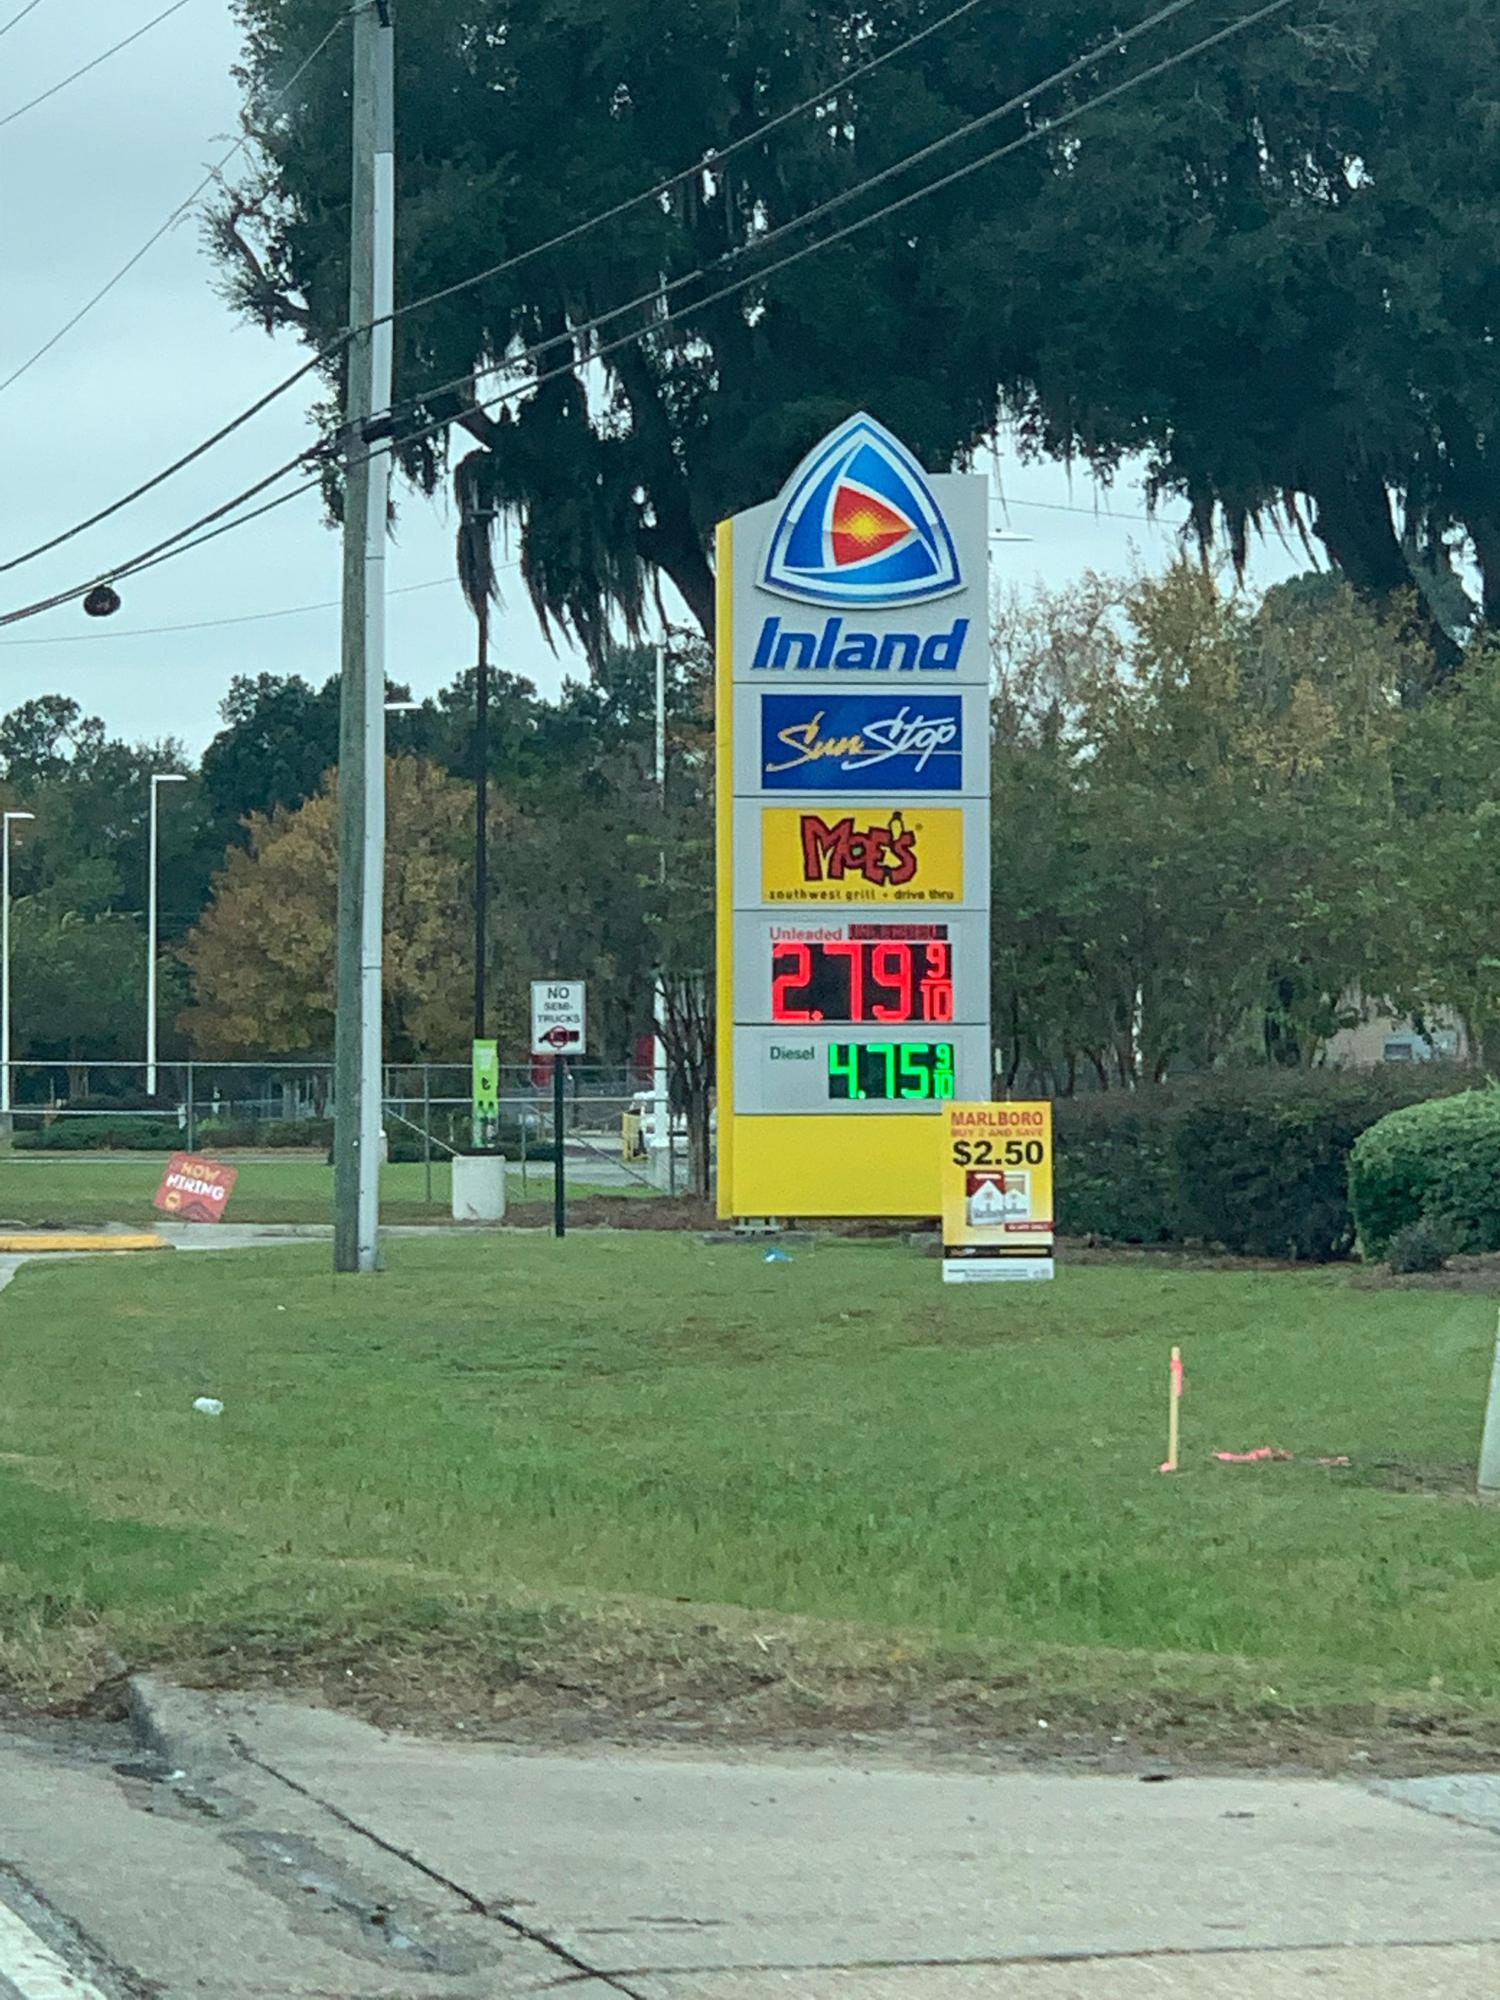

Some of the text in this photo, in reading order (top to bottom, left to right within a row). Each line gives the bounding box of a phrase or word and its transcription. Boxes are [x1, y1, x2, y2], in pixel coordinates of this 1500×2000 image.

[751, 616, 970, 671] Inland
[766, 706, 957, 773] Sun Stop
[769, 888, 954, 901] southwest grill drive thru
[770, 926, 843, 941] Unleaded
[547, 986, 570, 1000] NO
[538, 1014, 581, 1024] TRUCKS
[770, 1045, 815, 1061] Diesel
[951, 1111, 1043, 1126] MARLBORO
[952, 1139, 1044, 1167] $2.50
[180, 1161, 221, 1182] NOW
[165, 1173, 225, 1201] HIRING
